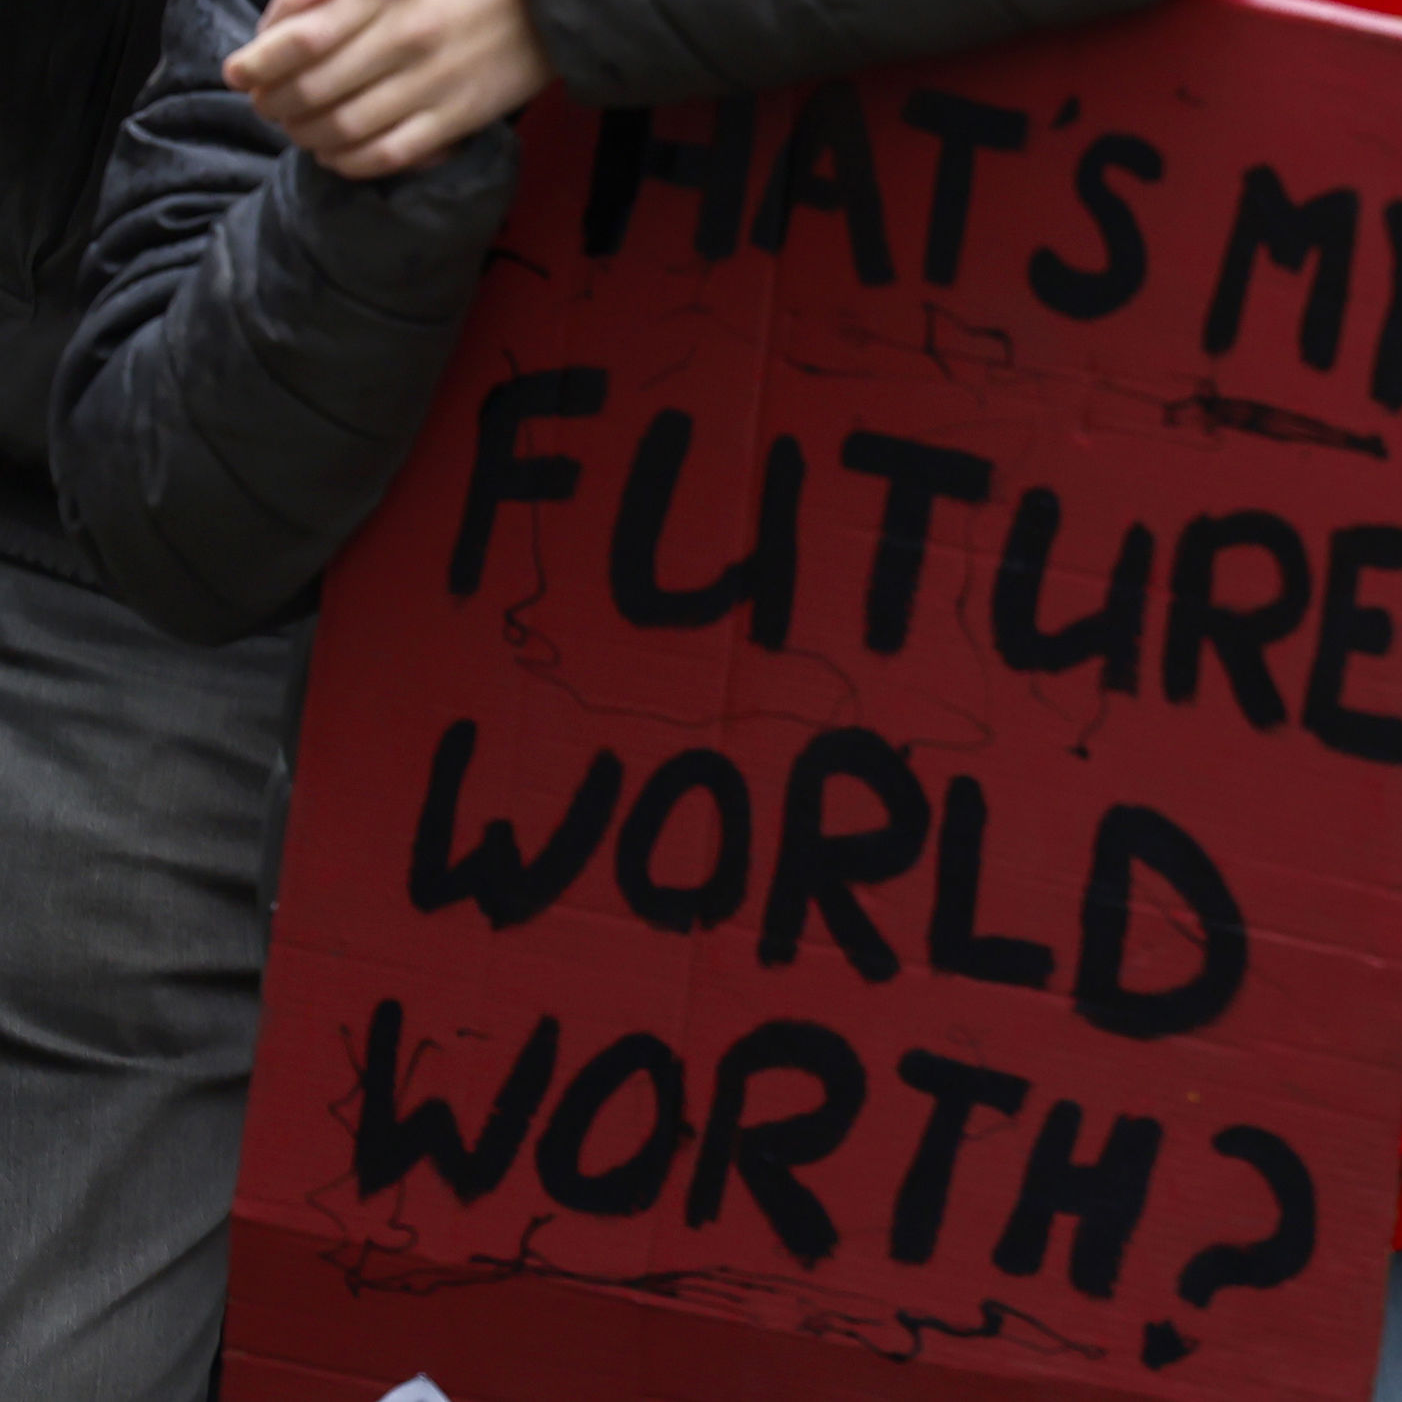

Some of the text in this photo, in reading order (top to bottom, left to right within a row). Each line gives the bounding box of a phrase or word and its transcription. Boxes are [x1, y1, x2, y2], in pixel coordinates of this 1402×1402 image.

[582, 78, 1166, 321] HAT'S
[407, 718, 1248, 1040] WORLD
[352, 998, 1316, 1371] WORTH?
